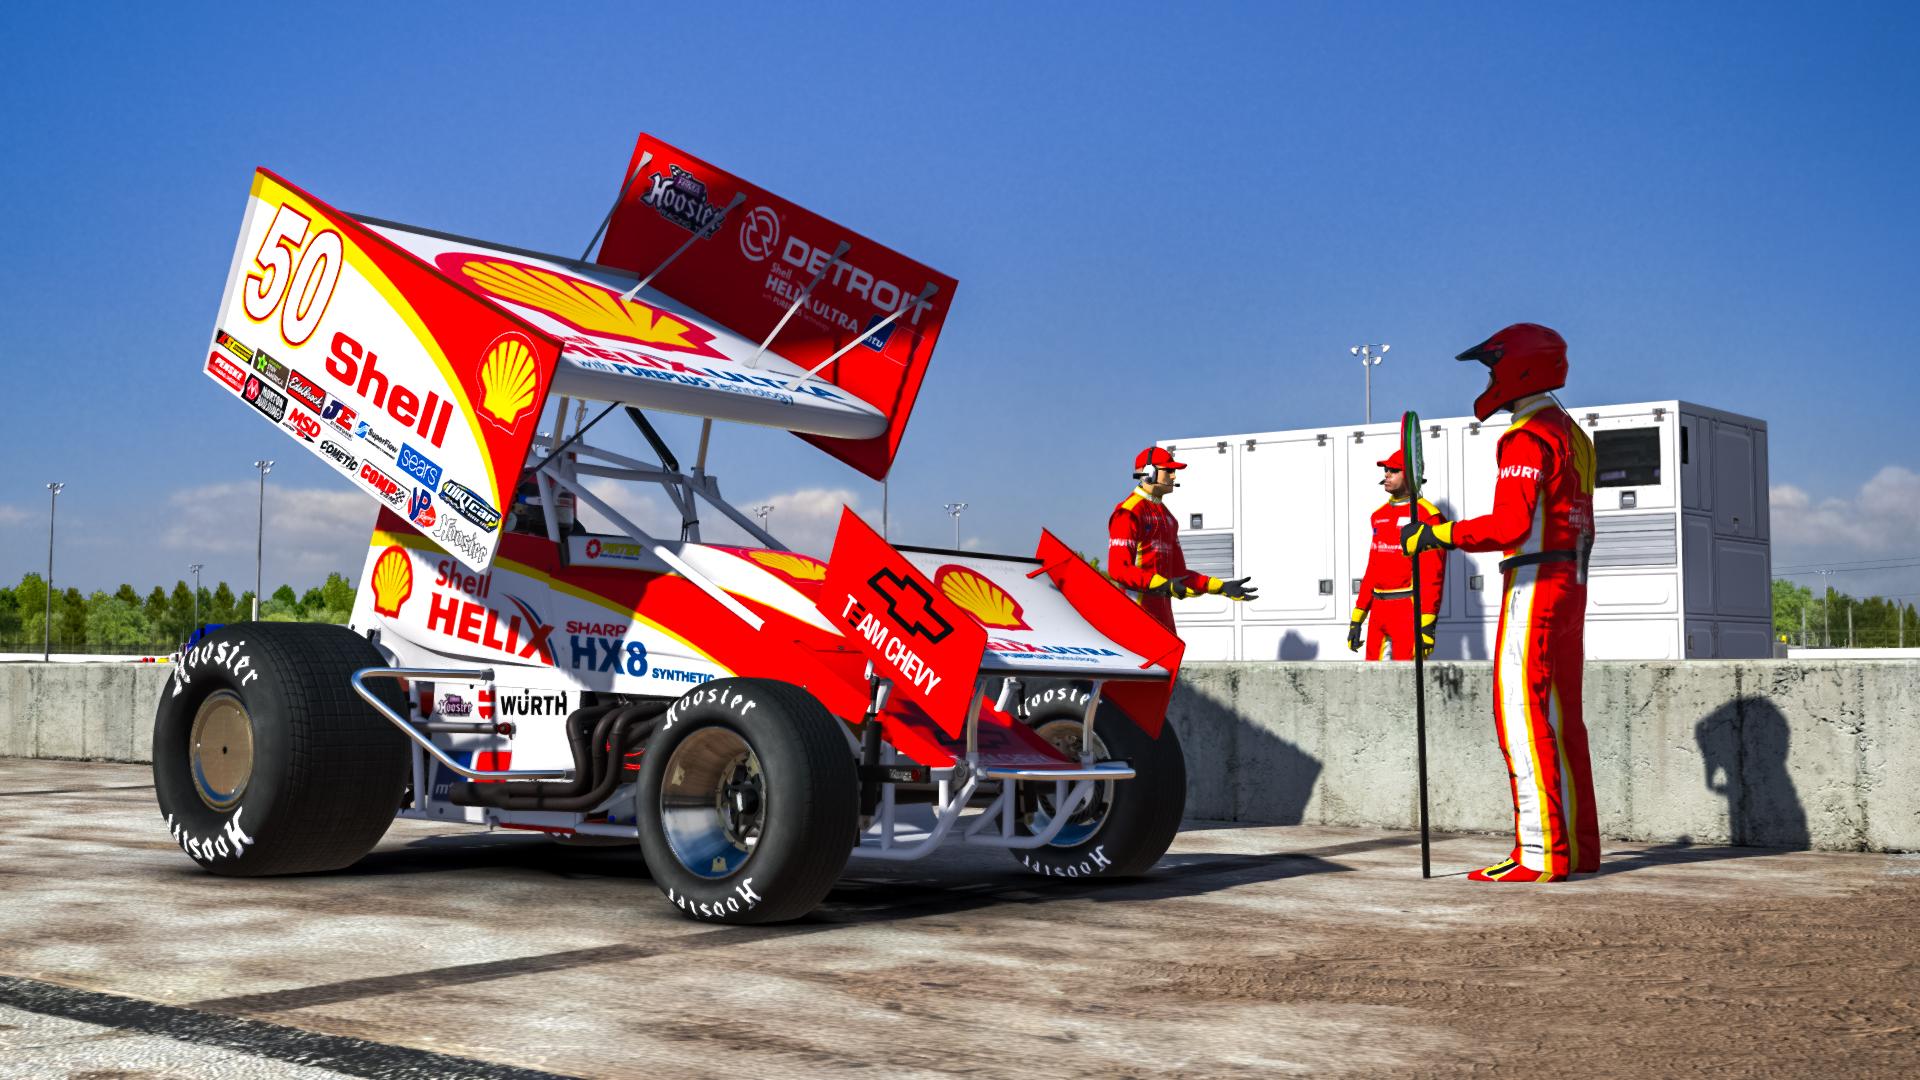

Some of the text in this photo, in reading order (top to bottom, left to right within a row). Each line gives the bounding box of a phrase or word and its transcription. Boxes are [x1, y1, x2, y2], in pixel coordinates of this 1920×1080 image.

[642, 174, 723, 232] Hoosie
[243, 202, 344, 347] 50
[770, 262, 792, 281] Shell
[782, 235, 932, 325] DETROIT
[812, 299, 858, 333] ULTRA
[325, 332, 453, 448] Shell
[578, 360, 613, 371] with
[612, 363, 711, 387] PUREPLUS
[288, 407, 321, 438] MSD
[322, 400, 357, 431] JE
[367, 427, 398, 453] SuperFlow
[360, 463, 398, 494] COMP
[401, 449, 438, 485] sears
[435, 559, 493, 599] Shell
[427, 592, 557, 668] HELIX
[566, 620, 627, 637] SHARP
[842, 593, 942, 696] TEAM CHEVY
[172, 639, 257, 697] Hoosier
[570, 635, 648, 678] HX8
[1041, 645, 1123, 657] ULTRA
[651, 667, 715, 684] SYNTHETIC
[438, 699, 474, 714] Hoosier
[500, 688, 568, 716] WÜRTH
[663, 685, 757, 731] Hoosier
[166, 806, 255, 862] Hoosier
[1023, 844, 1112, 876] Hoosier
[667, 876, 762, 918] Hoosier
